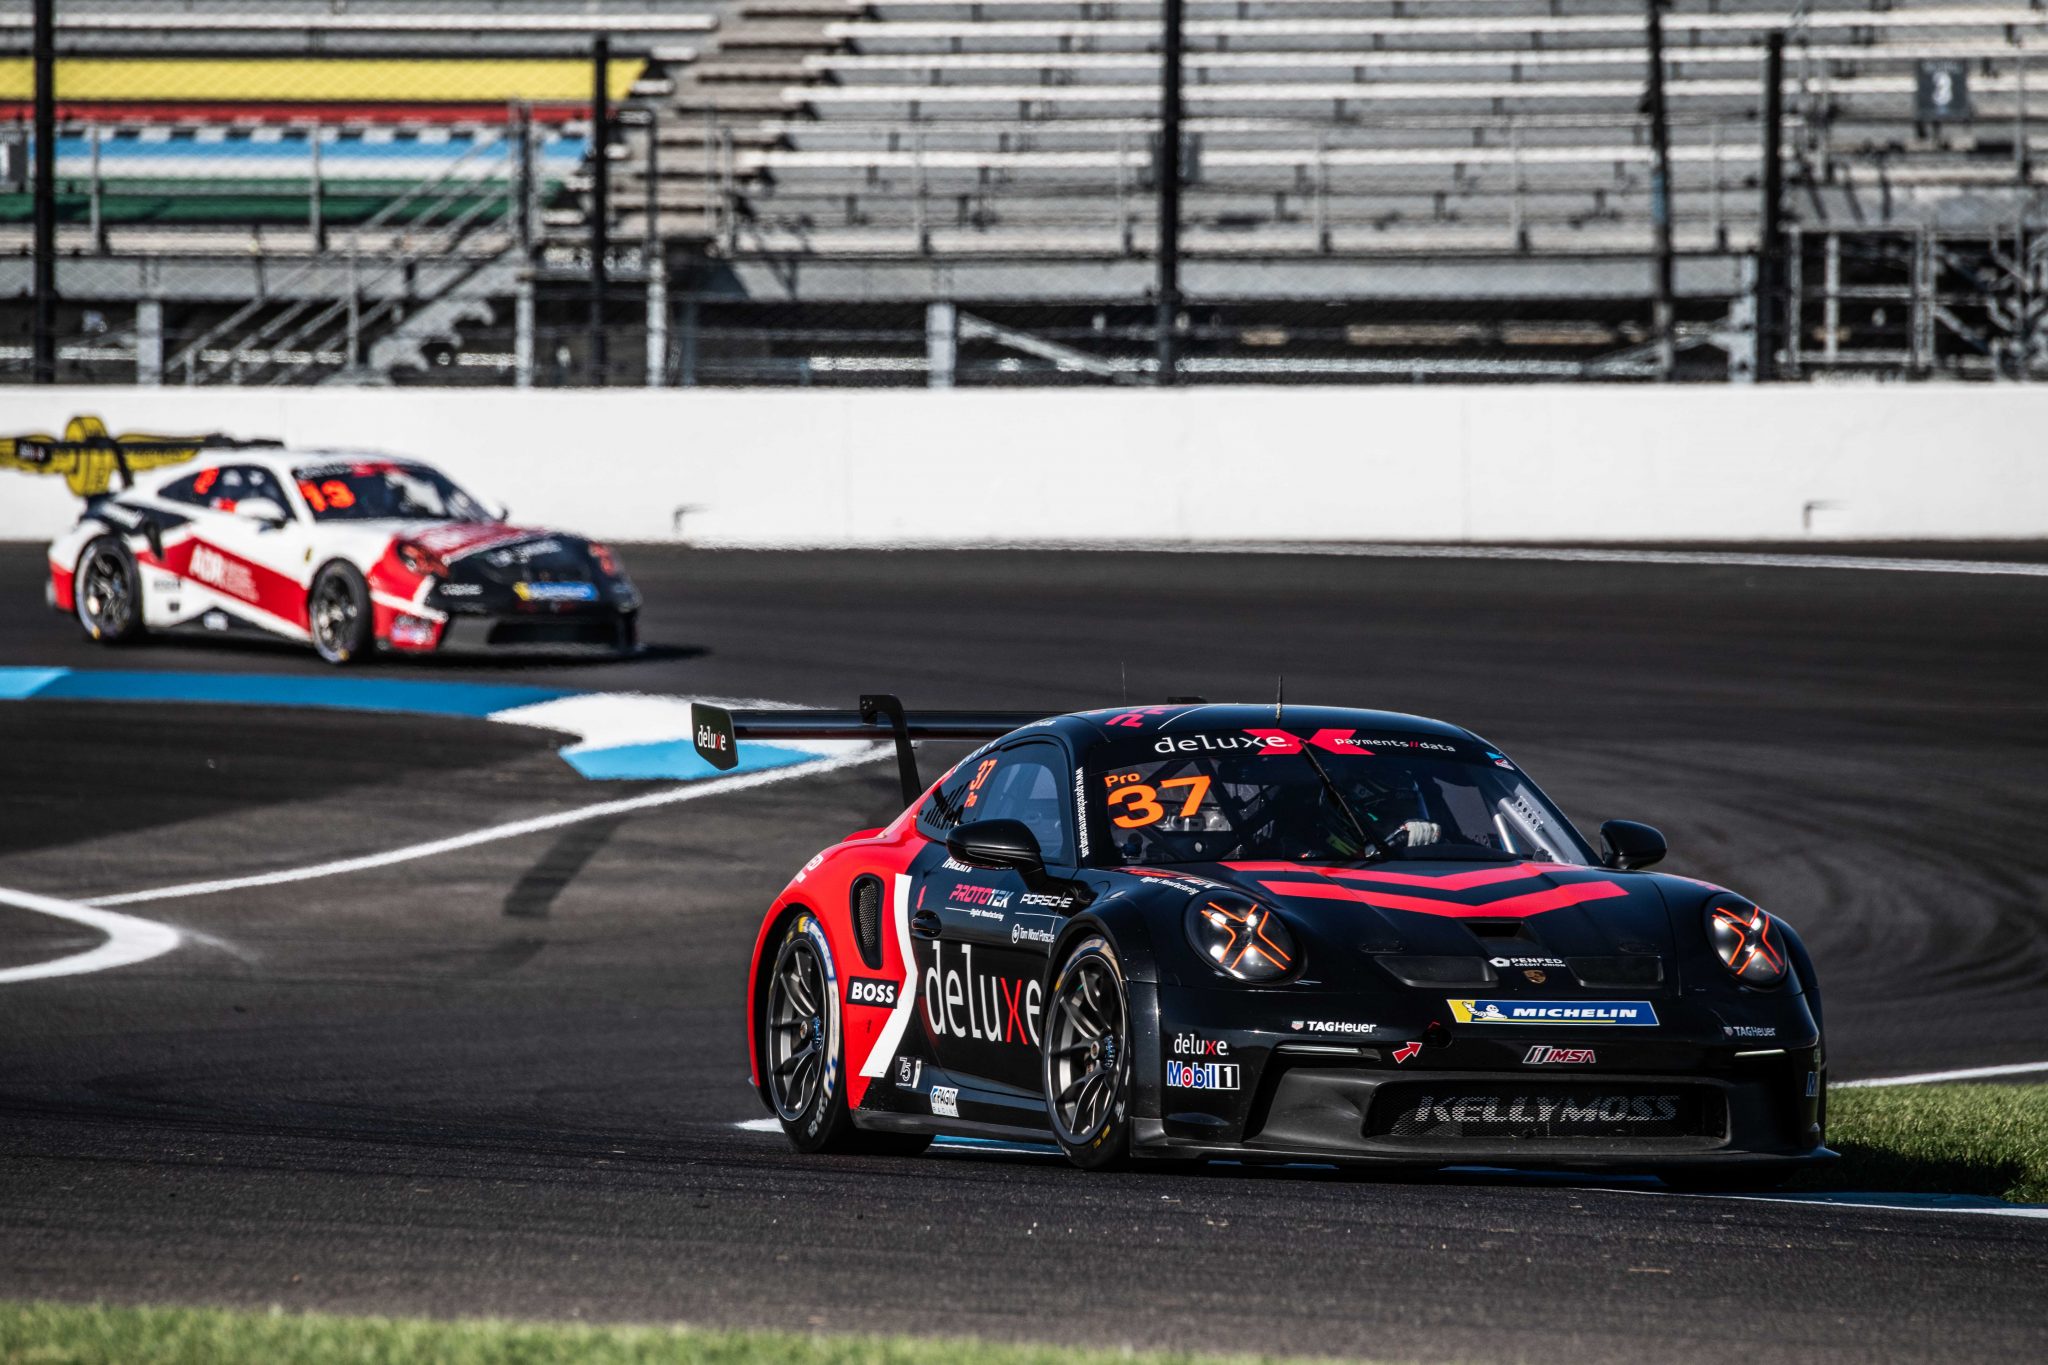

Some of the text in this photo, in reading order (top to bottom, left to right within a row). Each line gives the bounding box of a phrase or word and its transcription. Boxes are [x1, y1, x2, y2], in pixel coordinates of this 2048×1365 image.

[294, 479, 356, 514] 13
[697, 724, 727, 751] deluxe
[1153, 734, 1287, 753] deluxe
[970, 759, 998, 791] 37
[1104, 772, 1141, 788] Pro
[1107, 775, 1211, 829] 37
[949, 883, 1015, 908] PROTOTEK
[1019, 893, 1074, 909] PORSCHE
[1510, 957, 1563, 965] PENFED
[851, 981, 896, 1004] BOSS
[925, 940, 1042, 1048] deluxe
[1512, 1007, 1637, 1019] MICHELIN
[1173, 1033, 1229, 1056] deluxe
[1545, 1048, 1597, 1064] IMSA
[1166, 1060, 1217, 1089] Mobil
